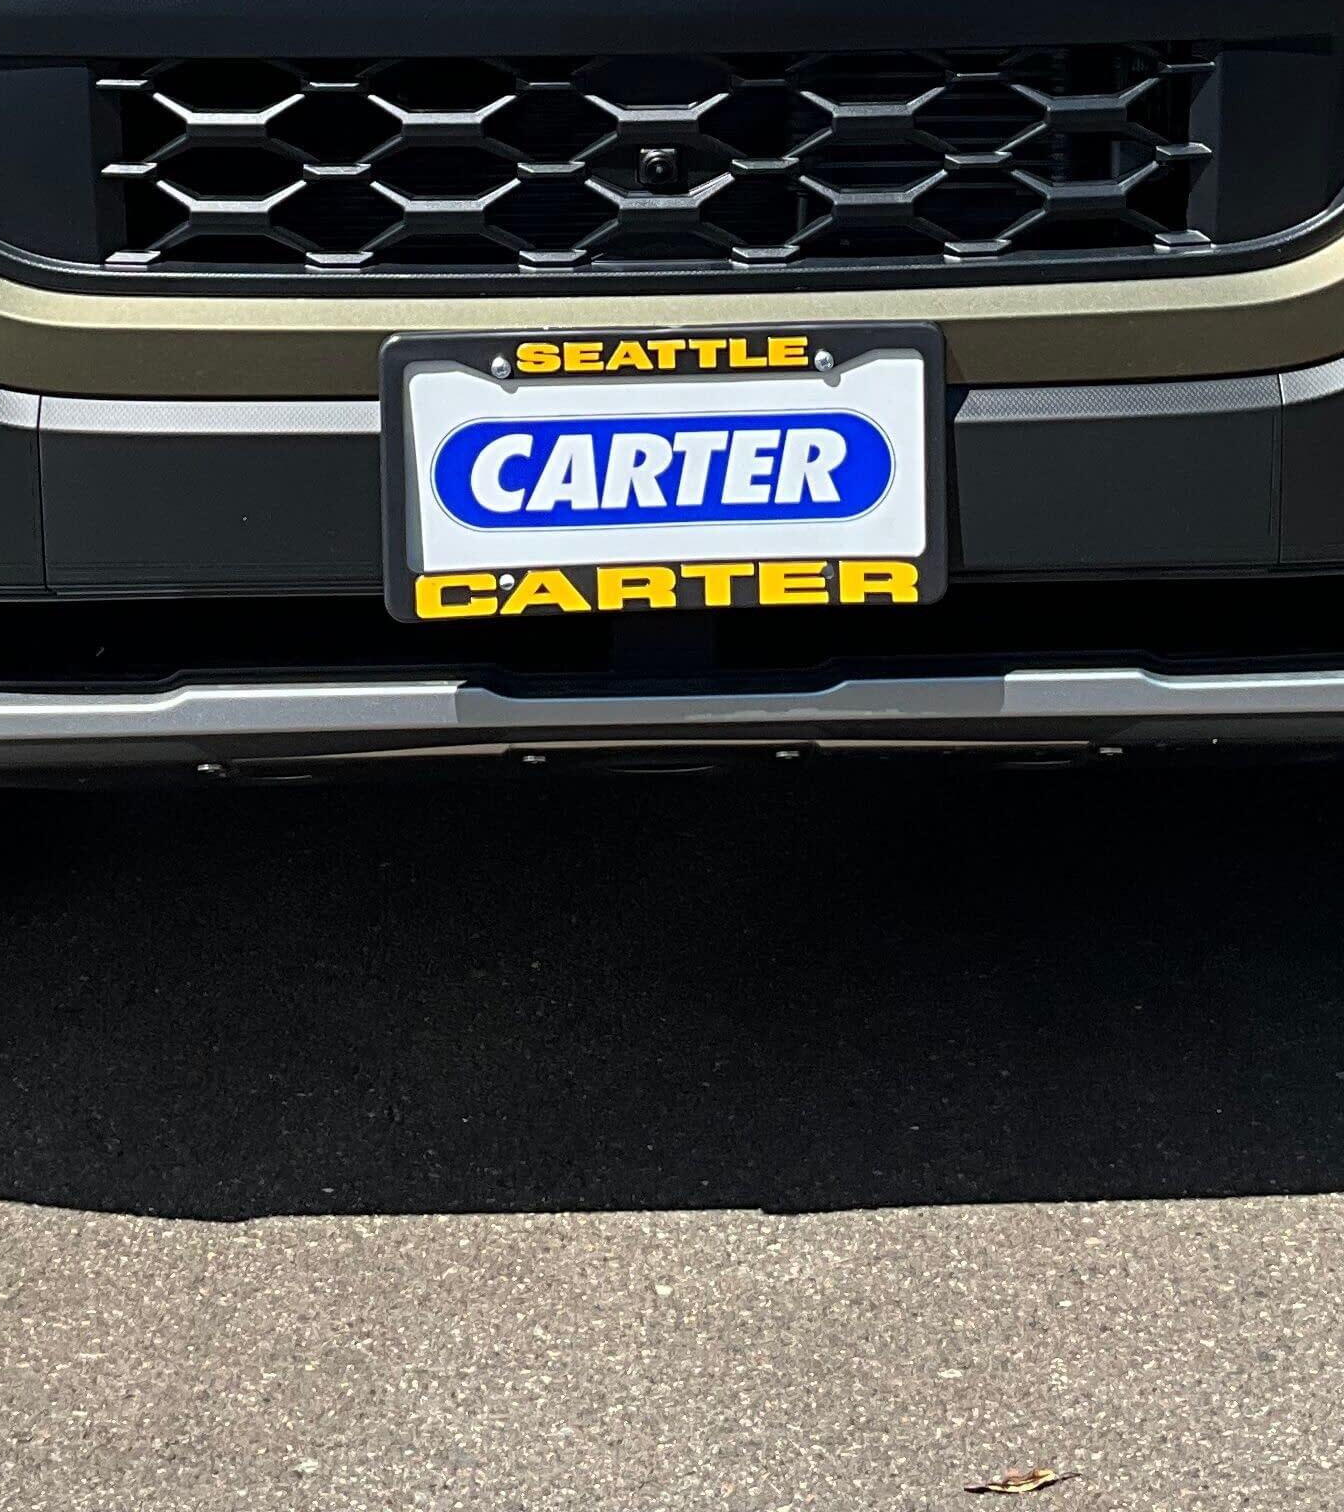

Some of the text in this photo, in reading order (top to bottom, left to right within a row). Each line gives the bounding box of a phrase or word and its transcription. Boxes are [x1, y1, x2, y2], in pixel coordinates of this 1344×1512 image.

[516, 337, 808, 374] SEATTLE
[470, 428, 847, 512] CARTER
[415, 560, 919, 619] CARTER
